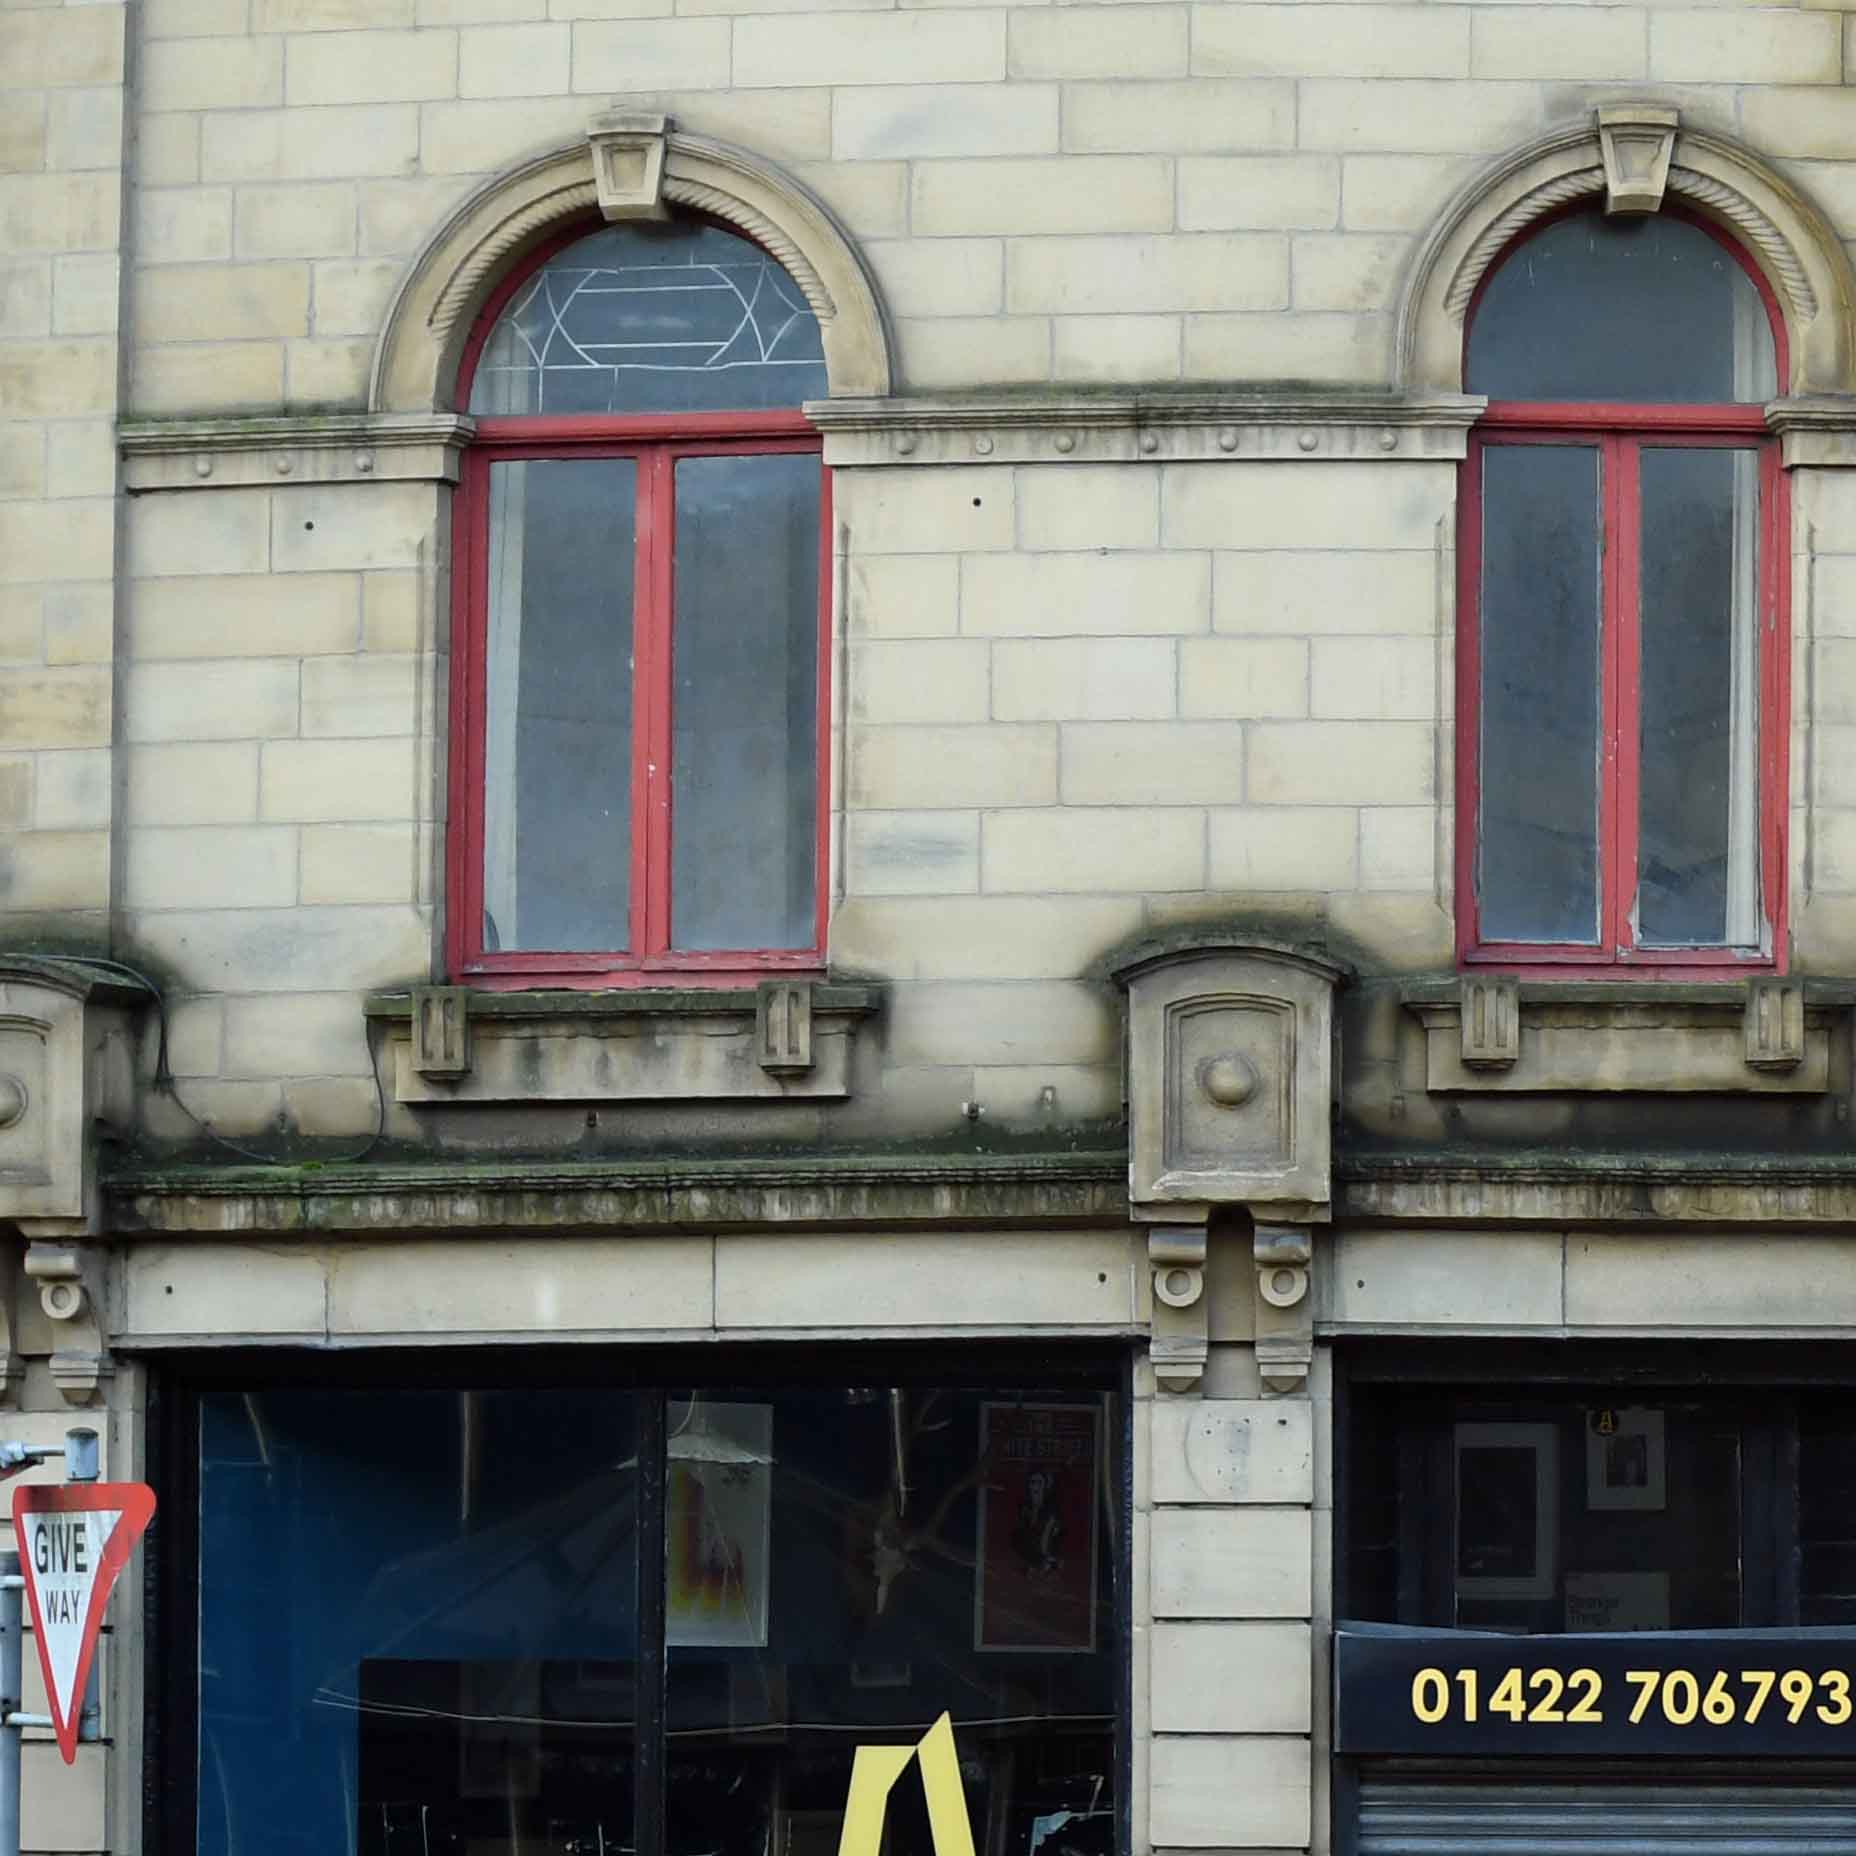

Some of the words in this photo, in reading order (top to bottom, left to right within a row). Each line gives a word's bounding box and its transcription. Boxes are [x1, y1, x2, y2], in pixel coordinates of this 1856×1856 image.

[34, 1522, 88, 1574] GIVE
[45, 1590, 80, 1625] WAY
[1411, 1668, 1604, 1723] 01422
[1625, 1669, 1854, 1726] 706793
